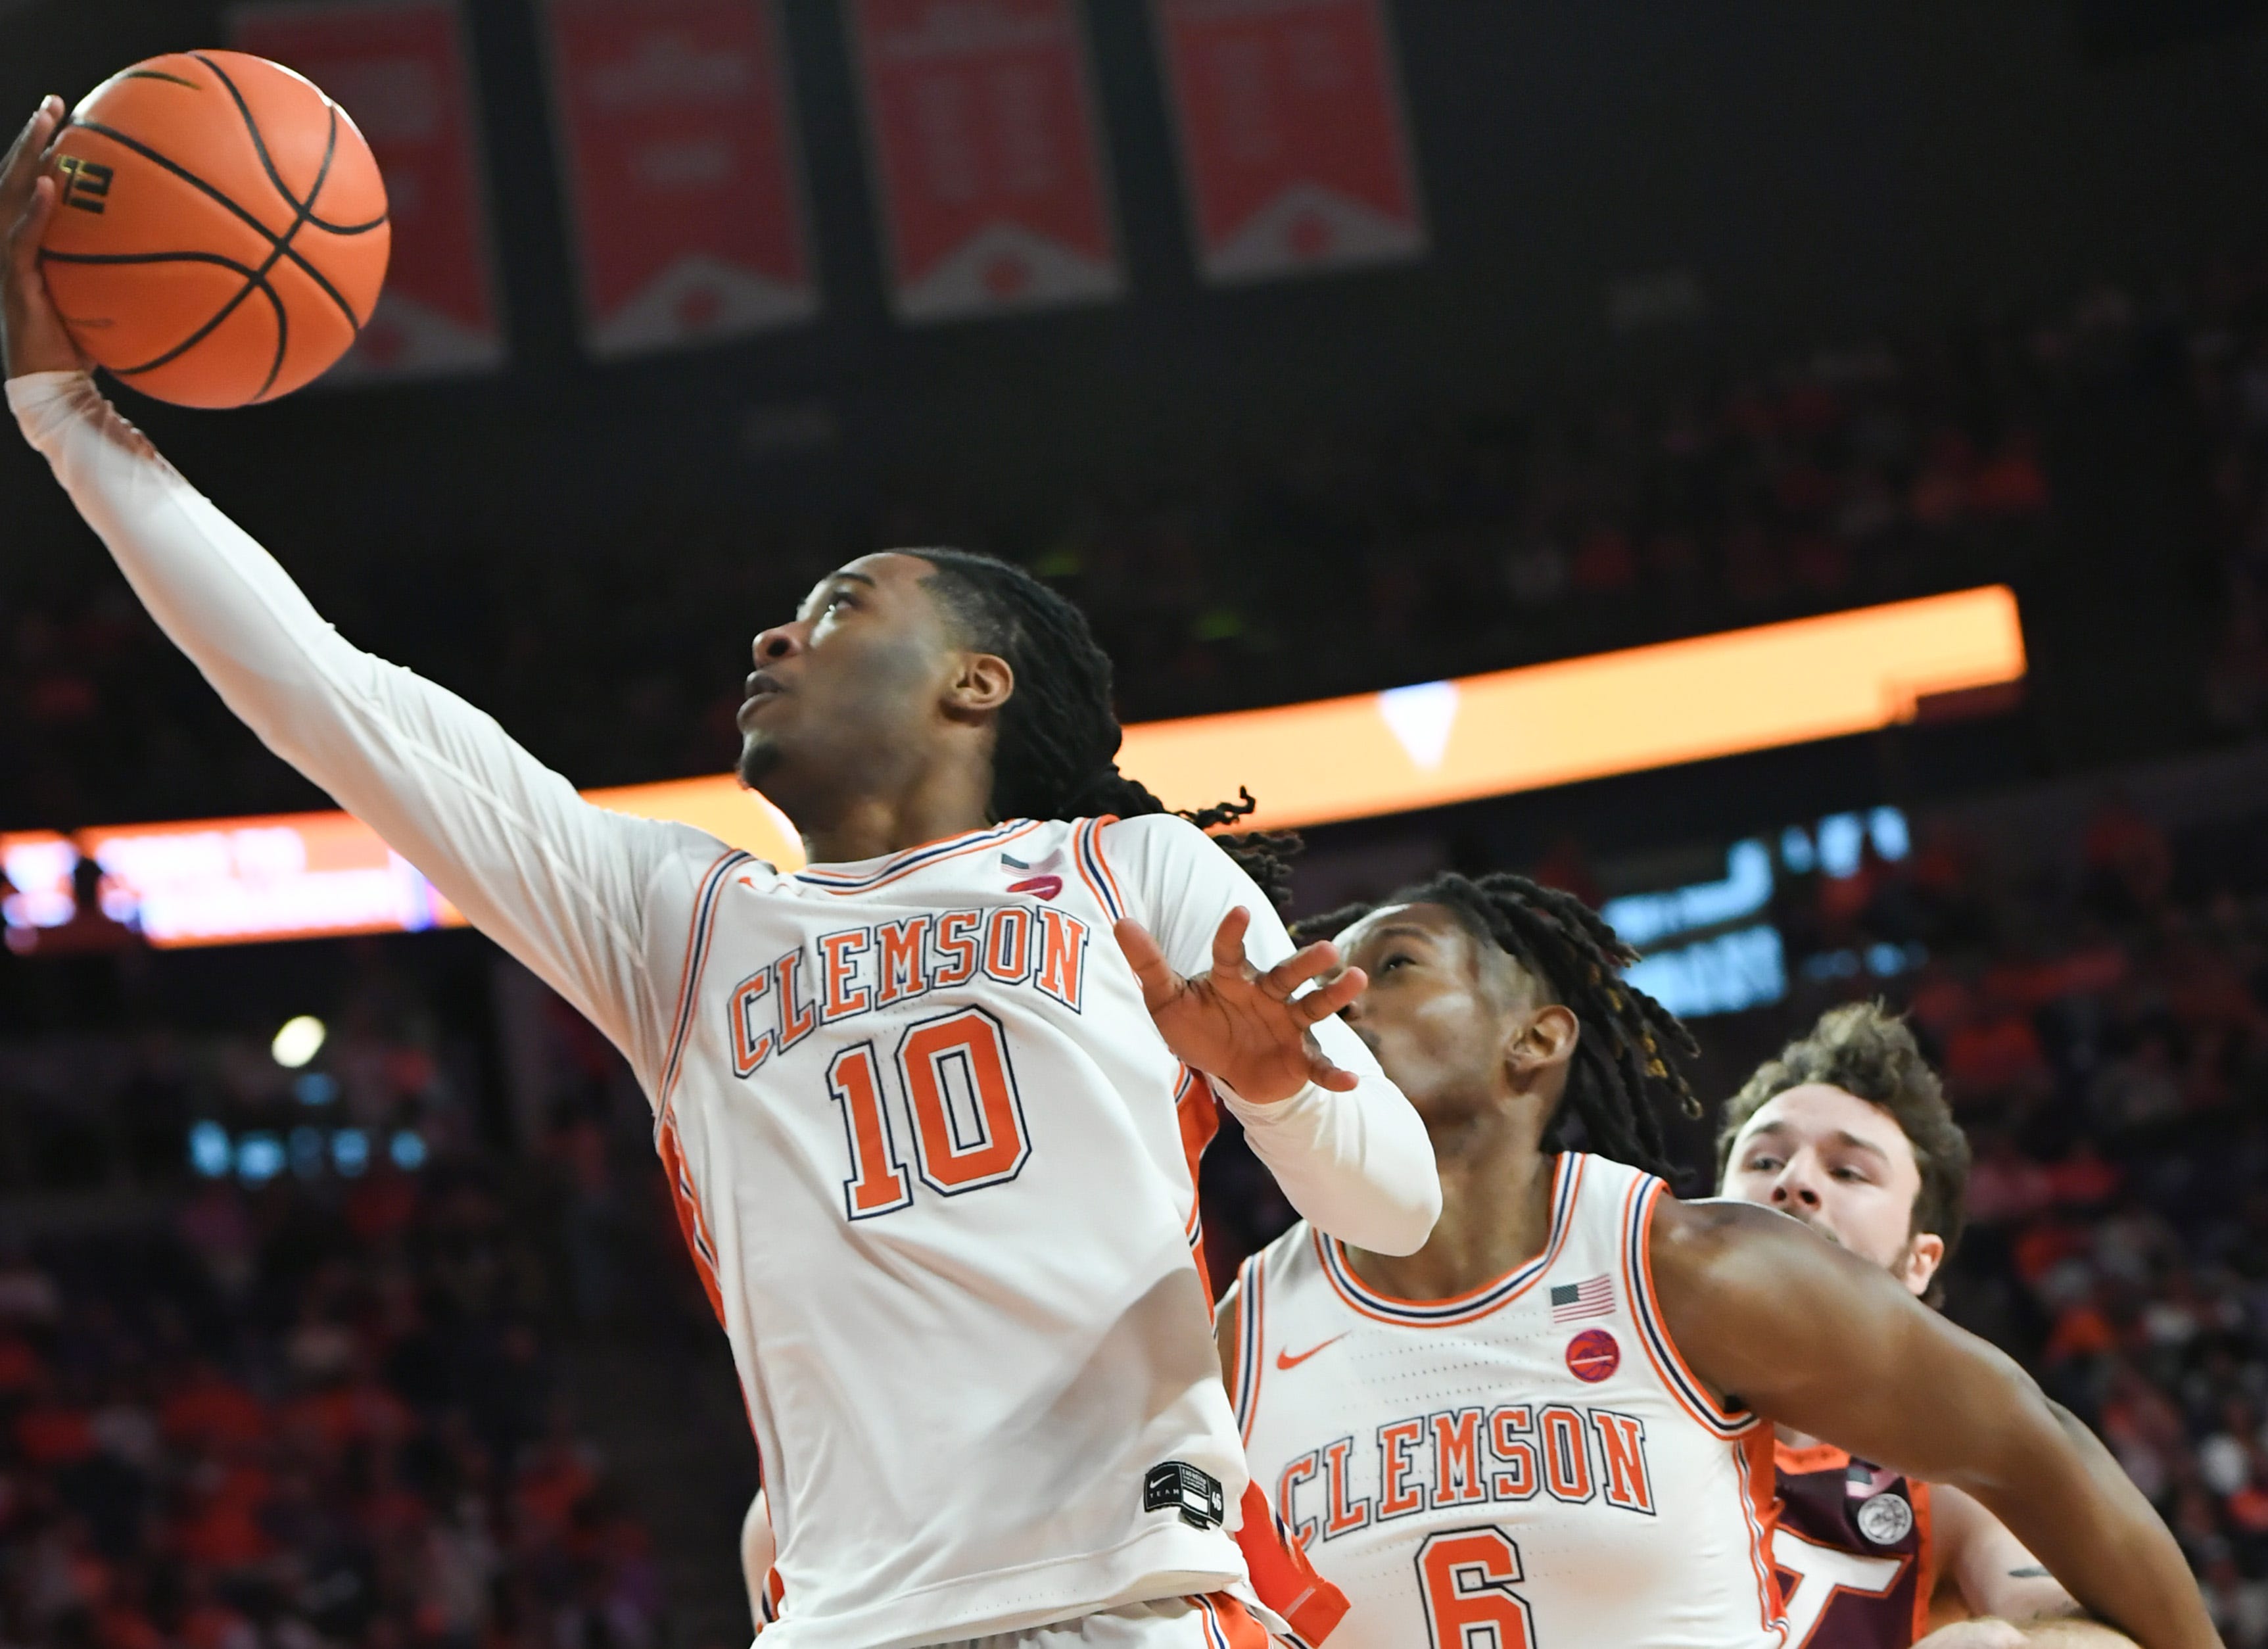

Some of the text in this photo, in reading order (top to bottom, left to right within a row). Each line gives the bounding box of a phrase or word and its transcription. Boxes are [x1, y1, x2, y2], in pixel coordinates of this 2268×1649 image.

[727, 905, 1090, 1080] CLEMSON
[826, 1003, 1032, 1222] 10
[1149, 1488, 1180, 1499] TEAM
[1276, 1404, 1657, 1553] CLEMSON
[1413, 1524, 1538, 1649] 6
